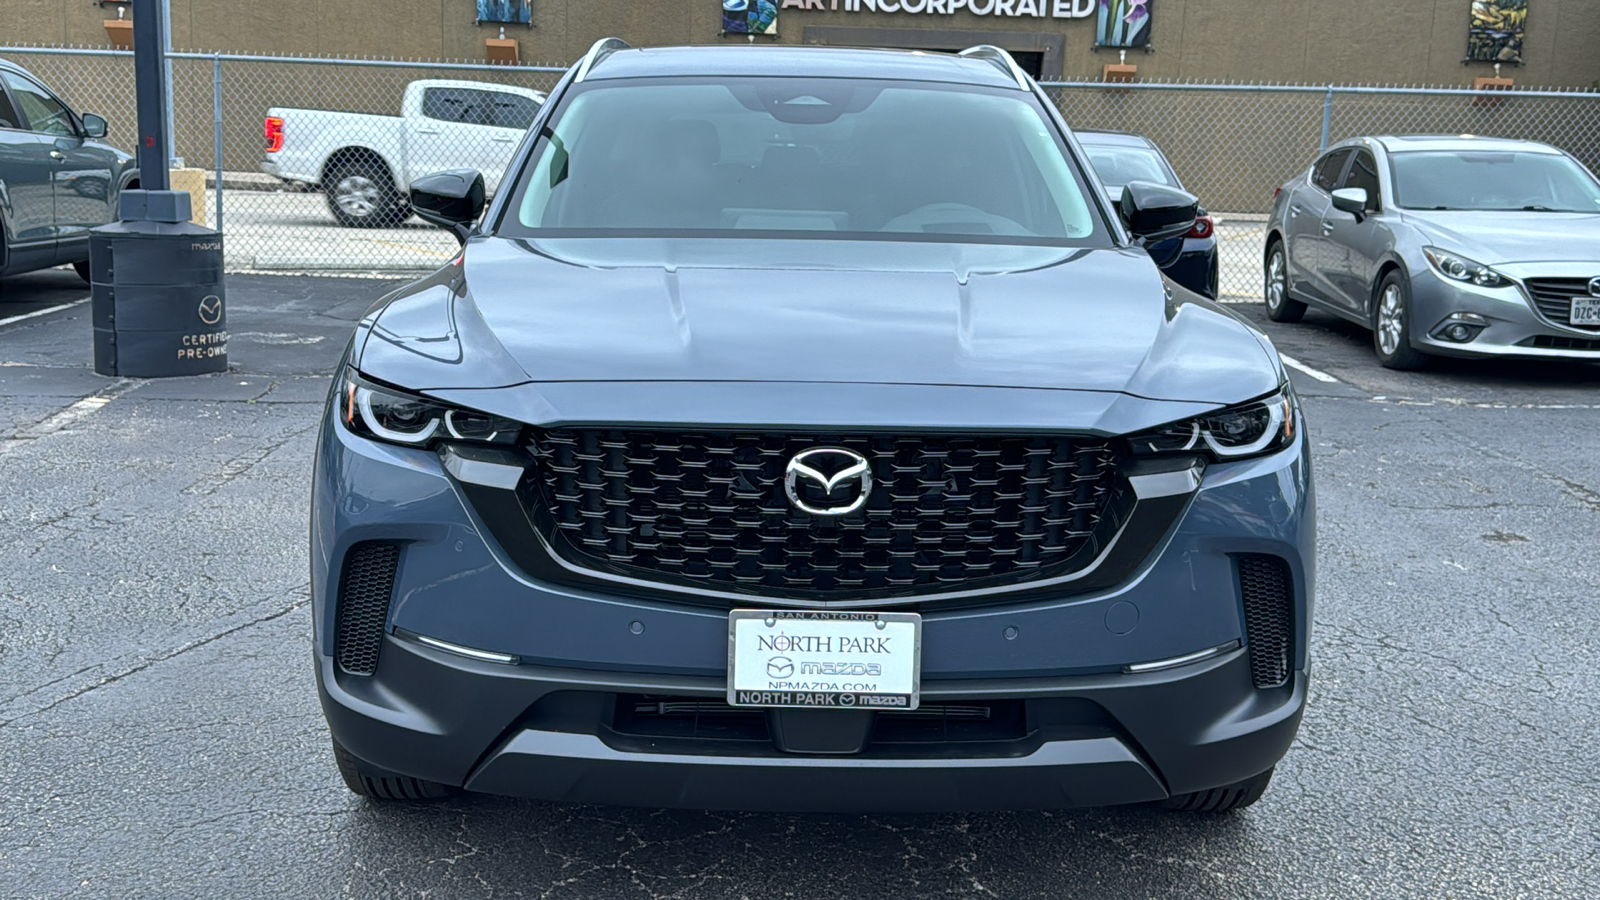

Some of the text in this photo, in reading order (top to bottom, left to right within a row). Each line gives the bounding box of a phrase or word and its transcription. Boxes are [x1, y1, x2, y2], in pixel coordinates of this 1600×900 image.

[757, 634, 891, 654] NORTH PARK
[801, 662, 881, 676] mazda
[768, 681, 877, 692] NPMAZDA.COM
[740, 691, 907, 706] NORTH PARK mazda
